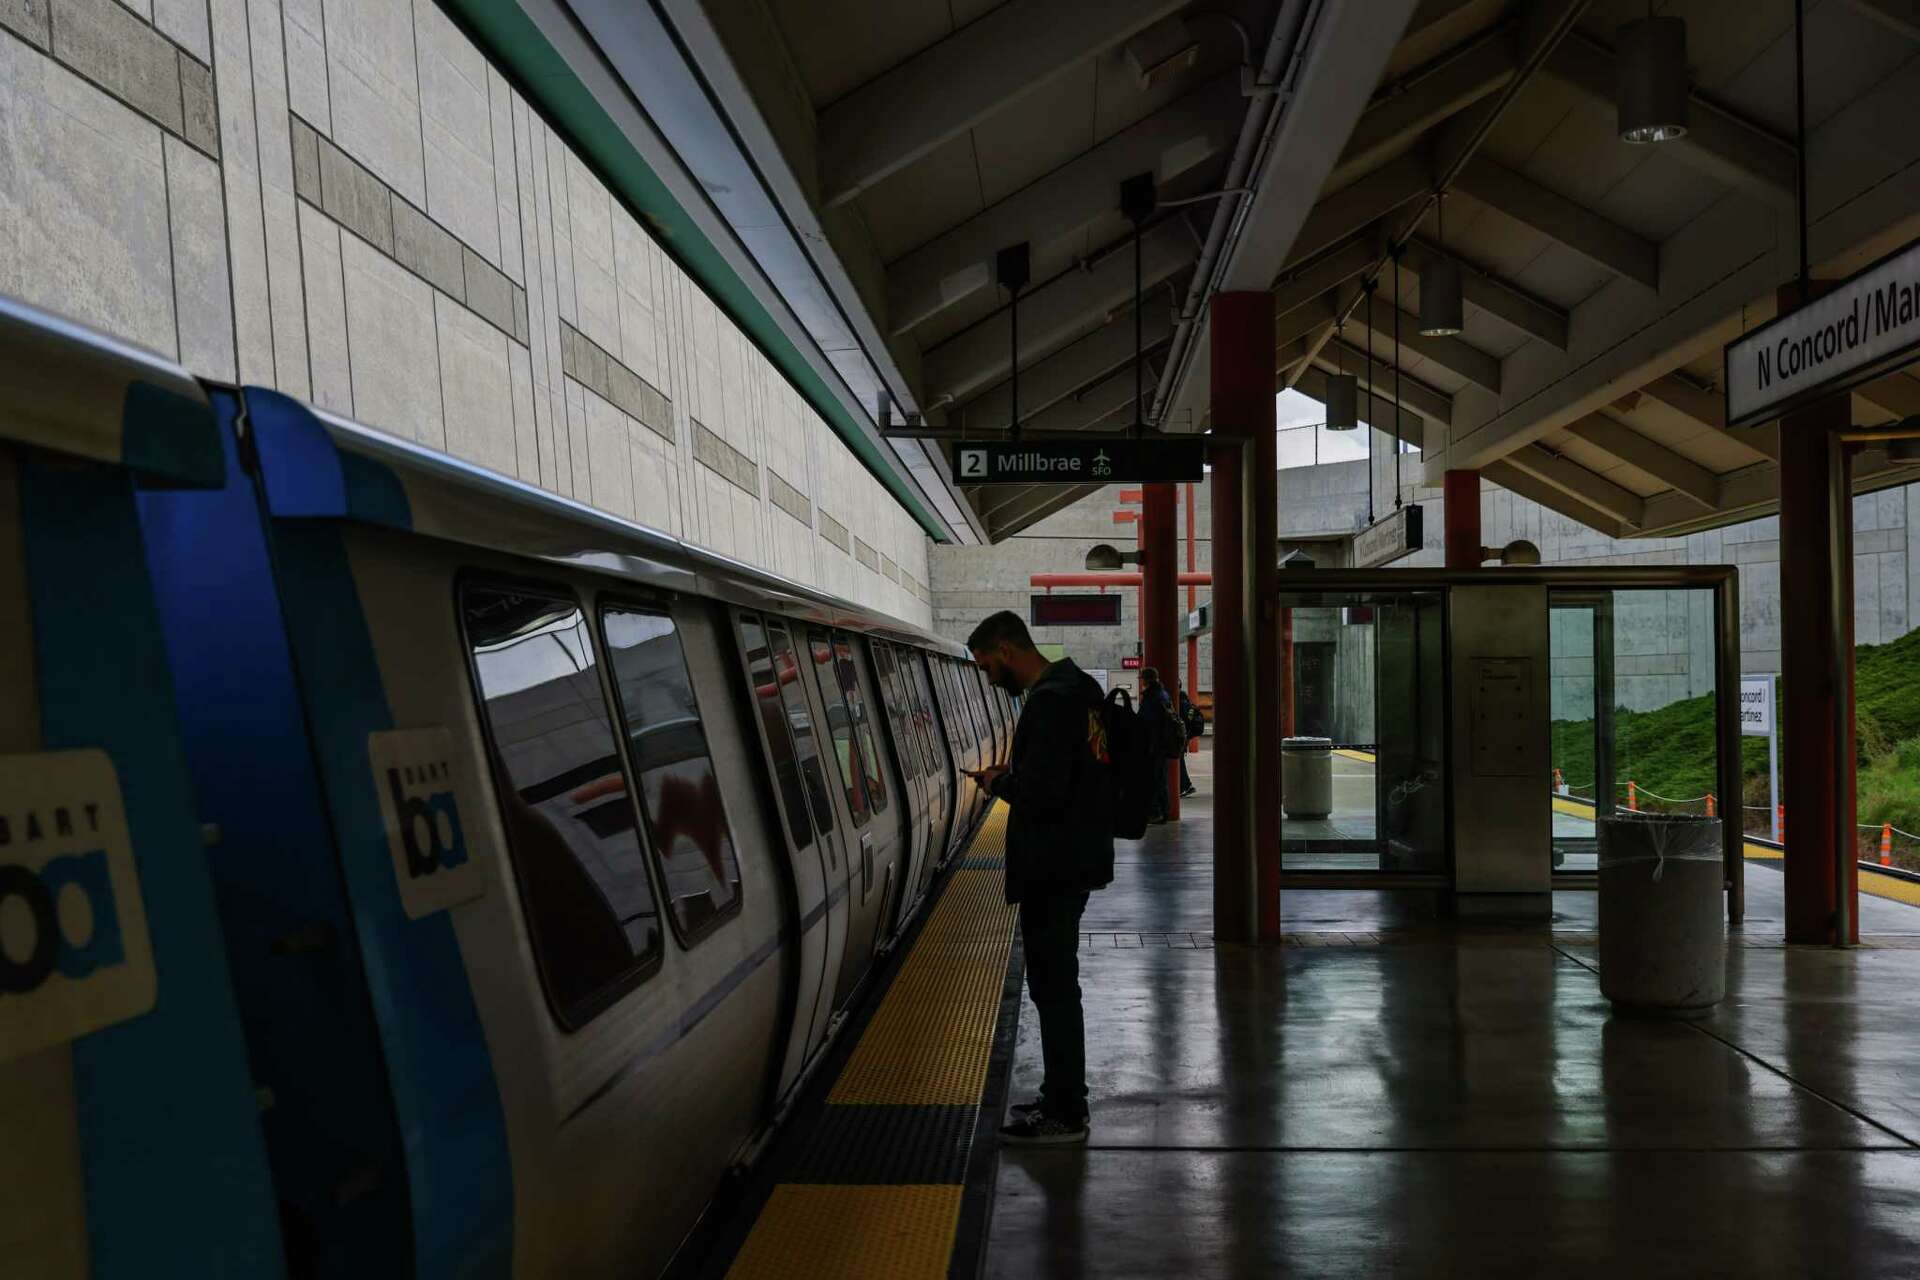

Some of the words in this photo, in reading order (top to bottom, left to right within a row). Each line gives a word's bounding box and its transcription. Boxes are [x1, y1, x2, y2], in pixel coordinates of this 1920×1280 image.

[1758, 346, 1771, 390] N
[966, 454, 981, 473] 2
[997, 453, 1082, 473] Millbrae
[1091, 466, 1112, 476] SFO
[404, 761, 449, 786] BART
